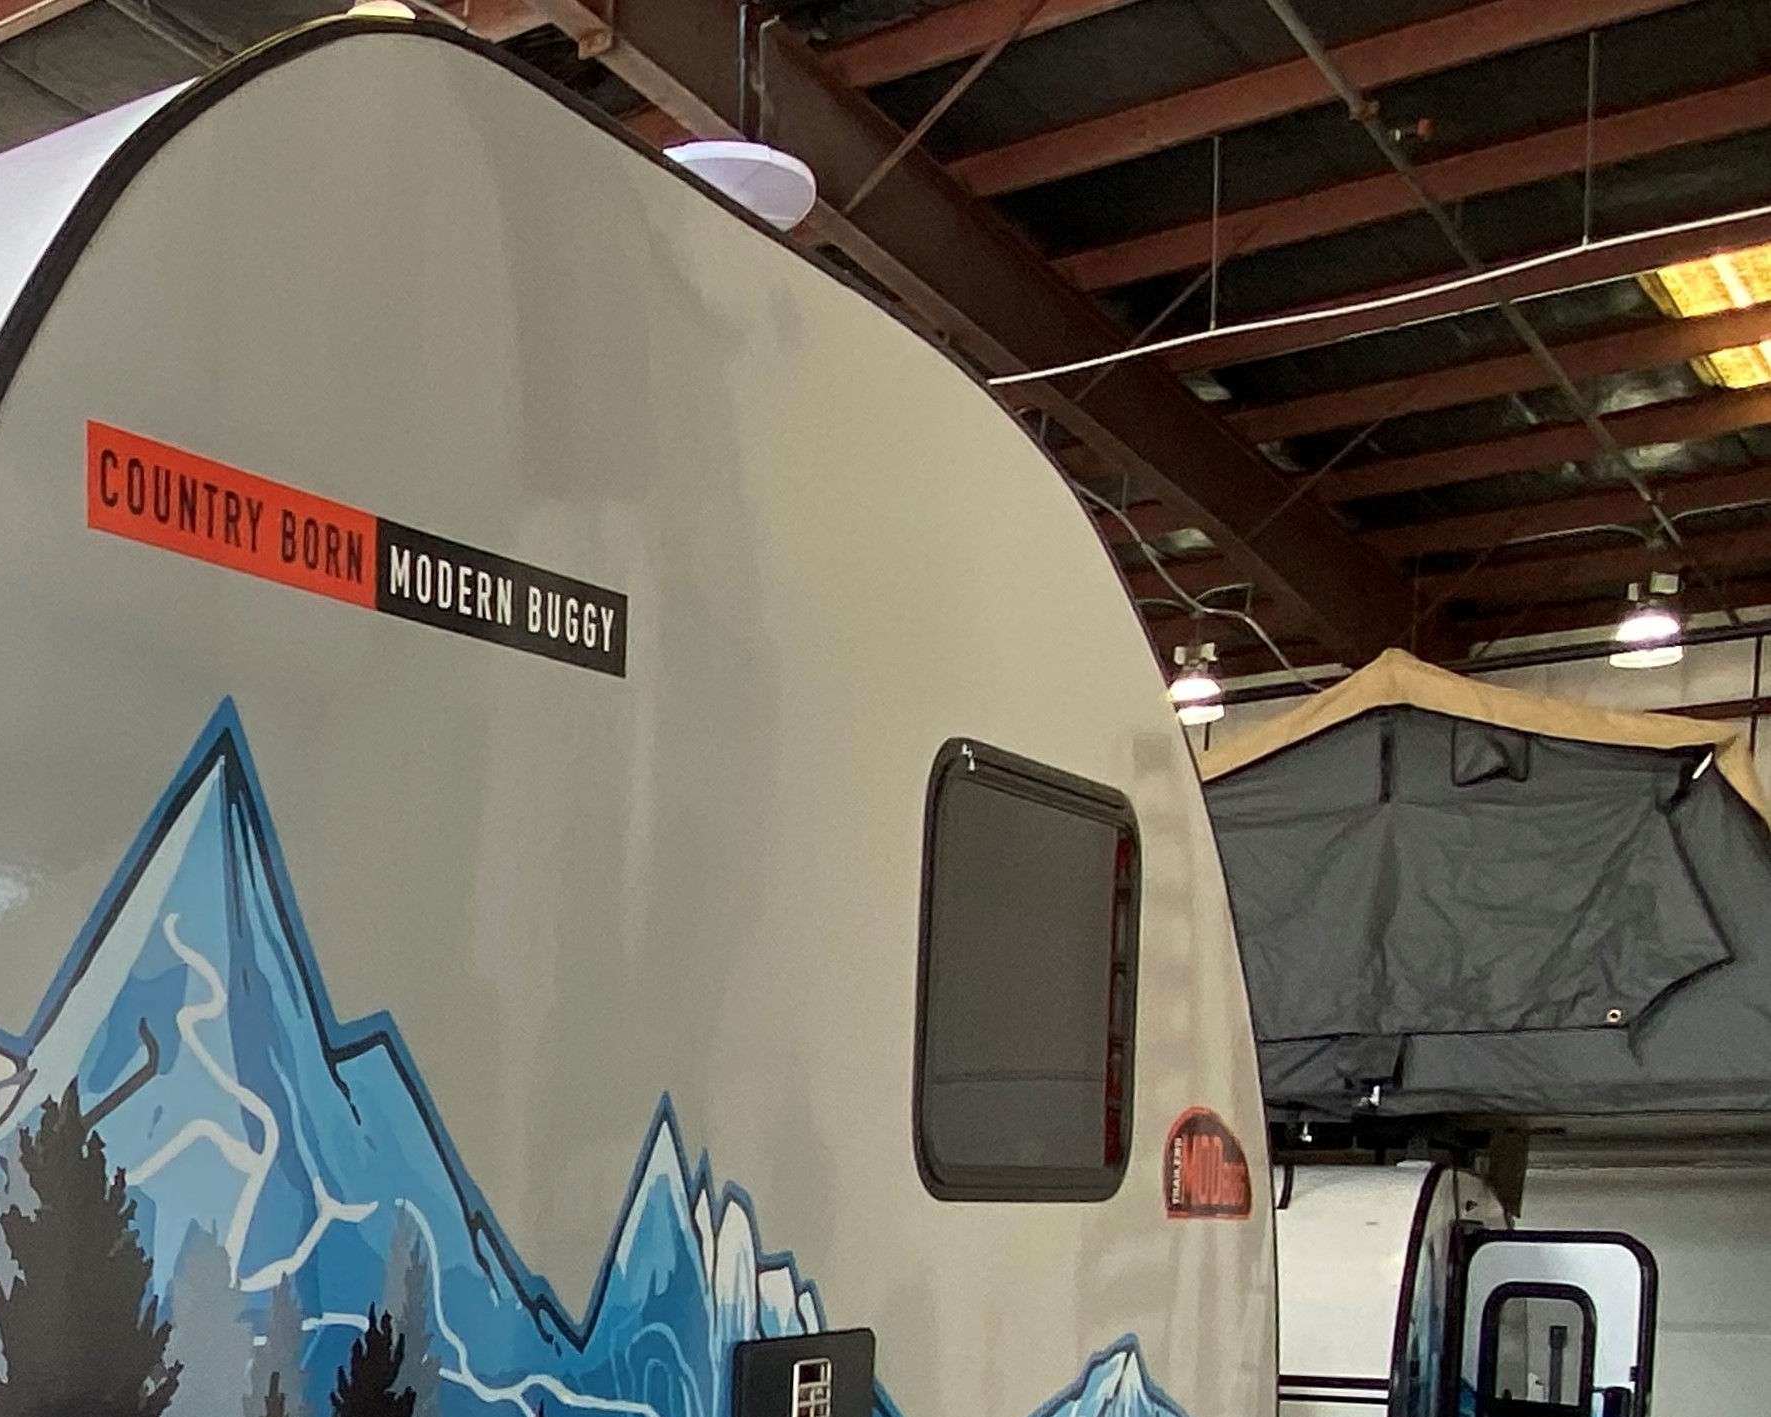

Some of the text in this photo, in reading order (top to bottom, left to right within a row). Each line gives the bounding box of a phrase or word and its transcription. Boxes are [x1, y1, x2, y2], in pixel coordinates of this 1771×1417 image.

[100, 448, 615, 652] COUNTRY BORN MODERN BUGGY
